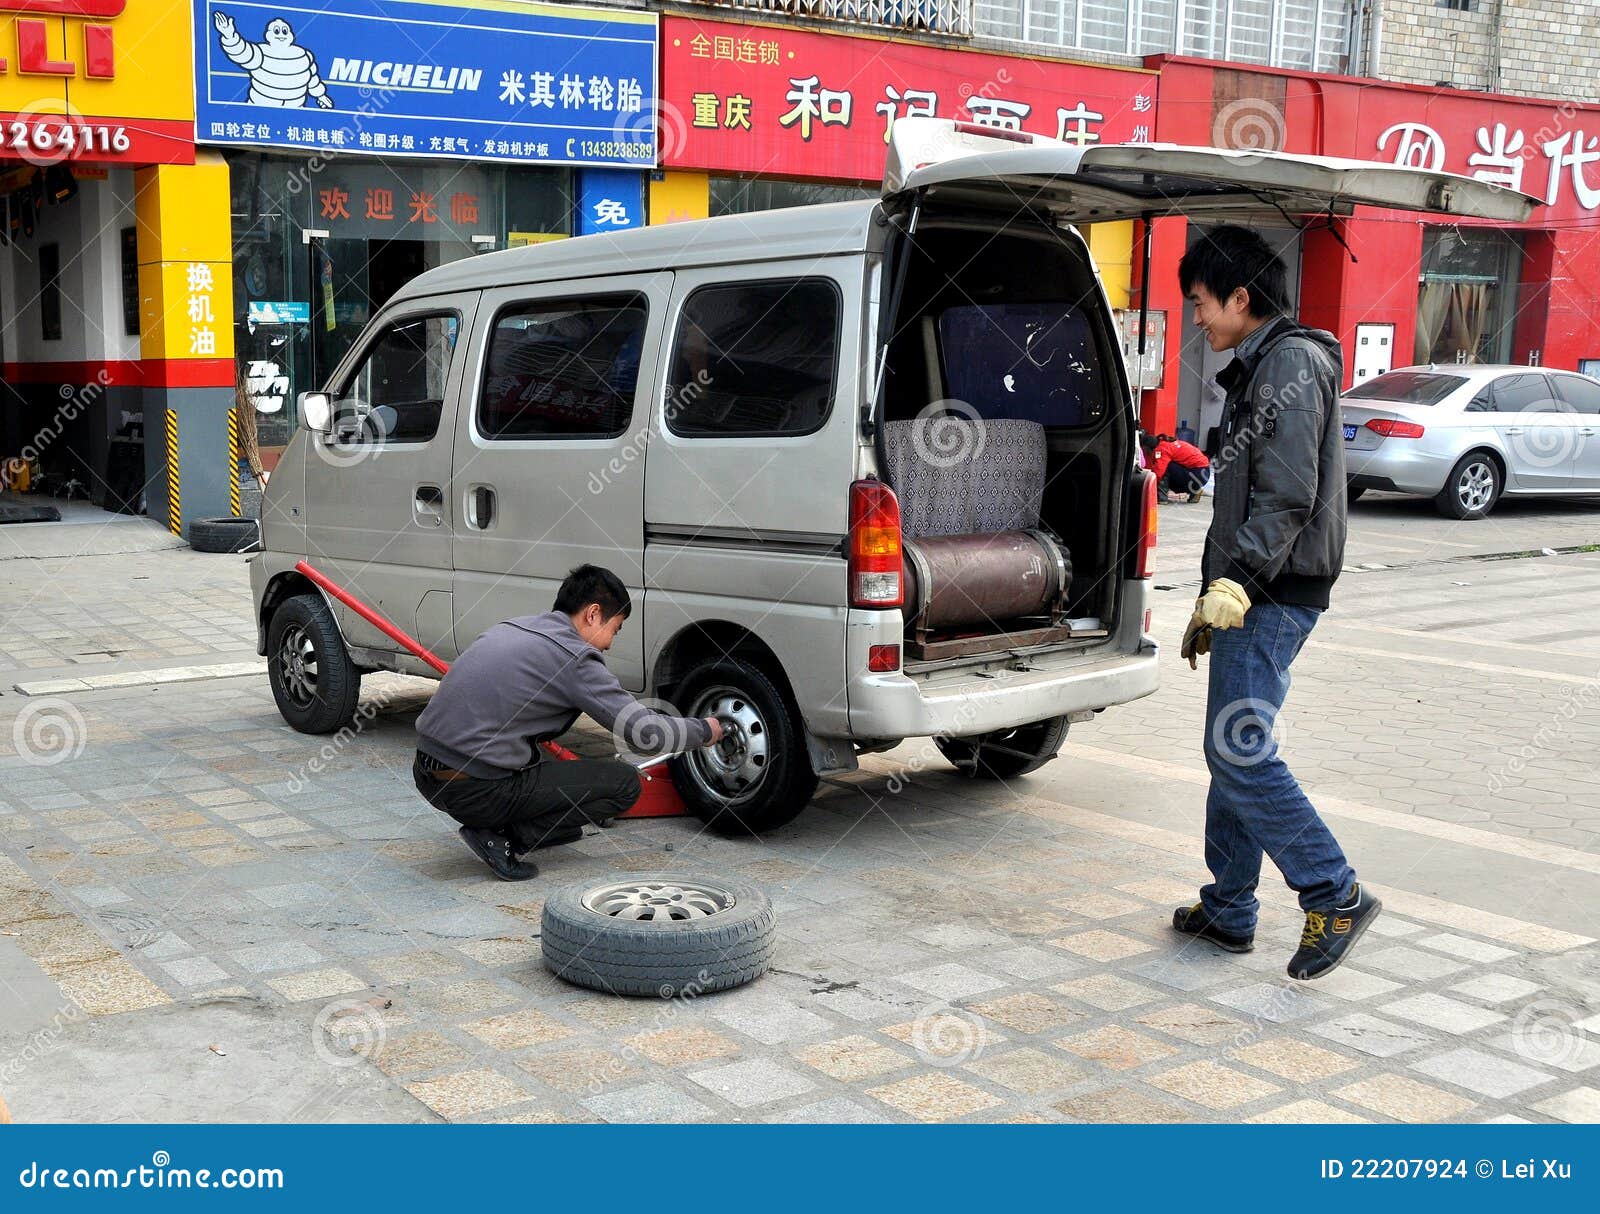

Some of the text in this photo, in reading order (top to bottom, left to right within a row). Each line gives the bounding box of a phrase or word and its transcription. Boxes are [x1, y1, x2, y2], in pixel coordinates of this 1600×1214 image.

[0, 17, 116, 80] LI
[690, 33, 780, 65] 全国连锁
[328, 57, 482, 91] MICHELIN
[498, 69, 643, 112] 米其林轮胎
[692, 92, 752, 130] 重庆
[211, 122, 652, 159] 四轮定位 机油电瓶 轮圈升级 充氮气 发动机护板 13438238589
[319, 186, 480, 225] 欢迎光临
[593, 198, 630, 234] 免
[186, 262, 216, 355] 换机油
